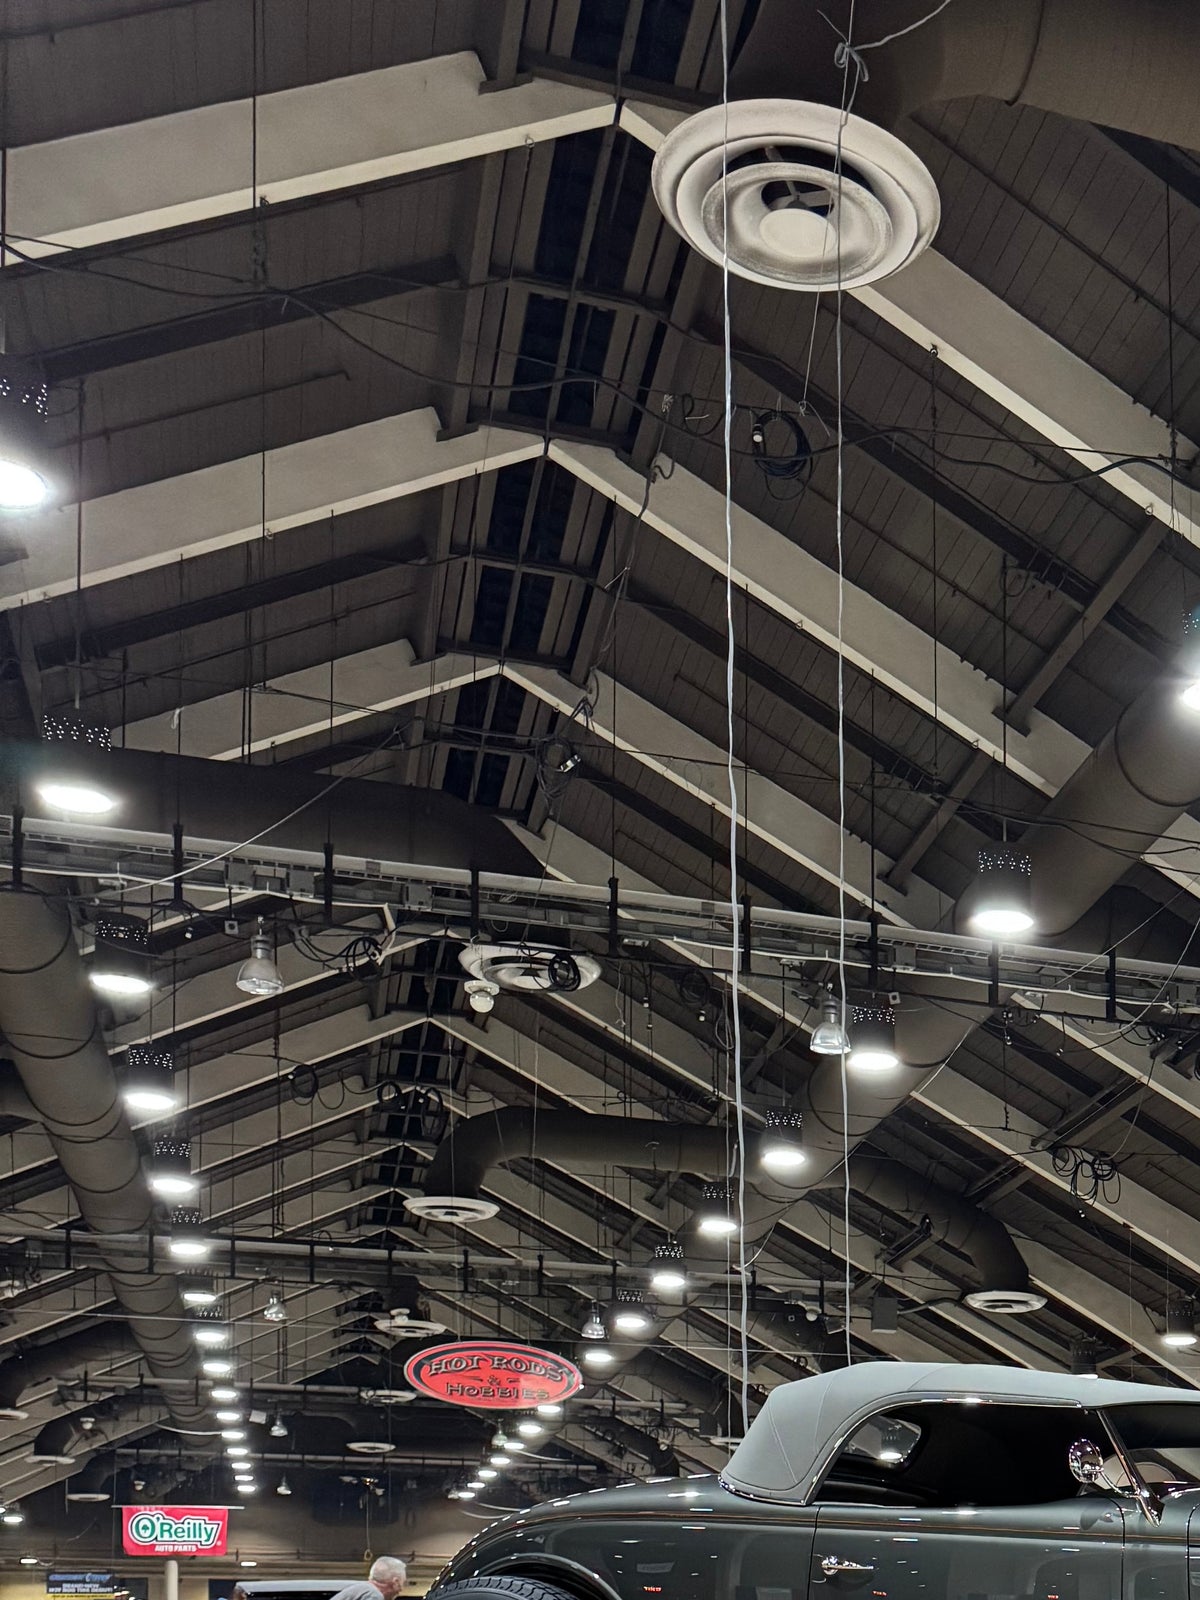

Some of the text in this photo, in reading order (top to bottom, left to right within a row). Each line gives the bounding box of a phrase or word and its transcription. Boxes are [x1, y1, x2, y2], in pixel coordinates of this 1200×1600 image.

[428, 1355, 565, 1383] HOT RODS
[445, 1382, 551, 1400] HOBBIES
[132, 1514, 217, 1544] O'Reilly
[154, 1544, 197, 1553] AUTO PARTS
